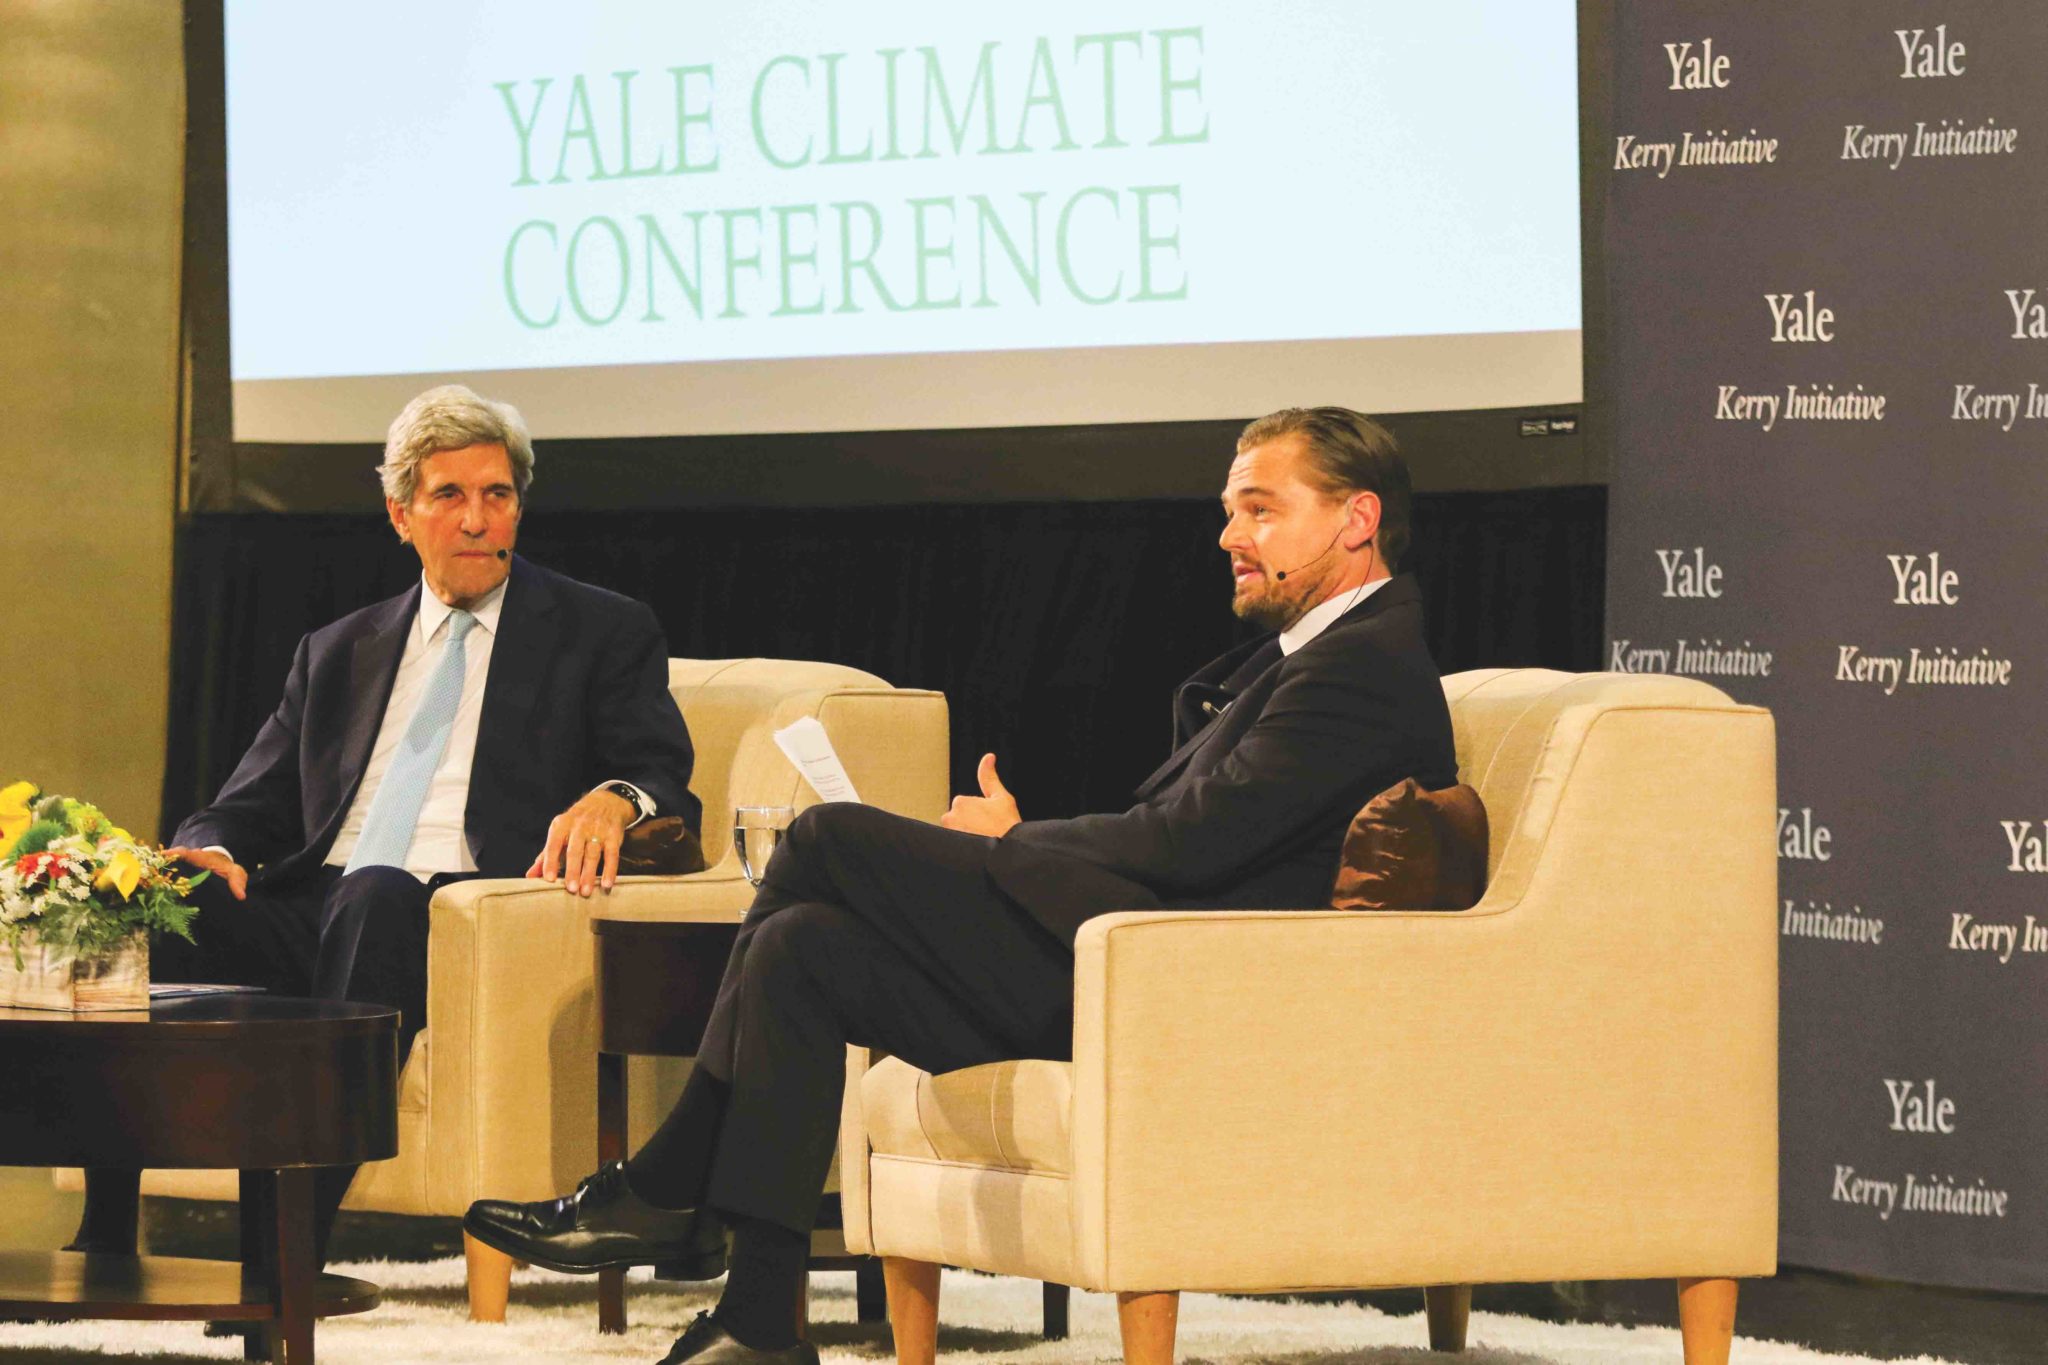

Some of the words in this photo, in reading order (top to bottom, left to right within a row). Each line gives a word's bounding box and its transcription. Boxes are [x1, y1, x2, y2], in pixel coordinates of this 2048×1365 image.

[1663, 38, 1731, 90] Yale
[1894, 24, 1966, 79] Yale
[492, 63, 720, 188] YALE
[750, 25, 1211, 170] CLIMATE
[1614, 135, 1675, 179] Kerry
[1679, 129, 1779, 166] Initiative
[1841, 125, 1907, 170] Kerry
[1912, 118, 2018, 157] Initiative
[503, 183, 1190, 330] CONFERENCE
[1764, 290, 1835, 343] Yale
[2004, 289, 2048, 339] Ya
[1715, 385, 1780, 432] Kerry
[1784, 384, 1886, 421] Initiative
[1951, 385, 2020, 432] Kerry
[1656, 547, 1723, 598] Yale
[1887, 552, 1960, 605] Yale
[1610, 639, 1670, 673] Kerry
[1674, 638, 1773, 676] Initiative
[1835, 646, 1902, 695] Kerry
[1907, 647, 2012, 686] Initiative
[1782, 900, 1884, 945] Initiative
[1949, 913, 2018, 964] Kerry
[1884, 1079, 1956, 1133] Yale
[1831, 1165, 1898, 1220] Kerry
[1902, 1174, 2008, 1217] Initiative
